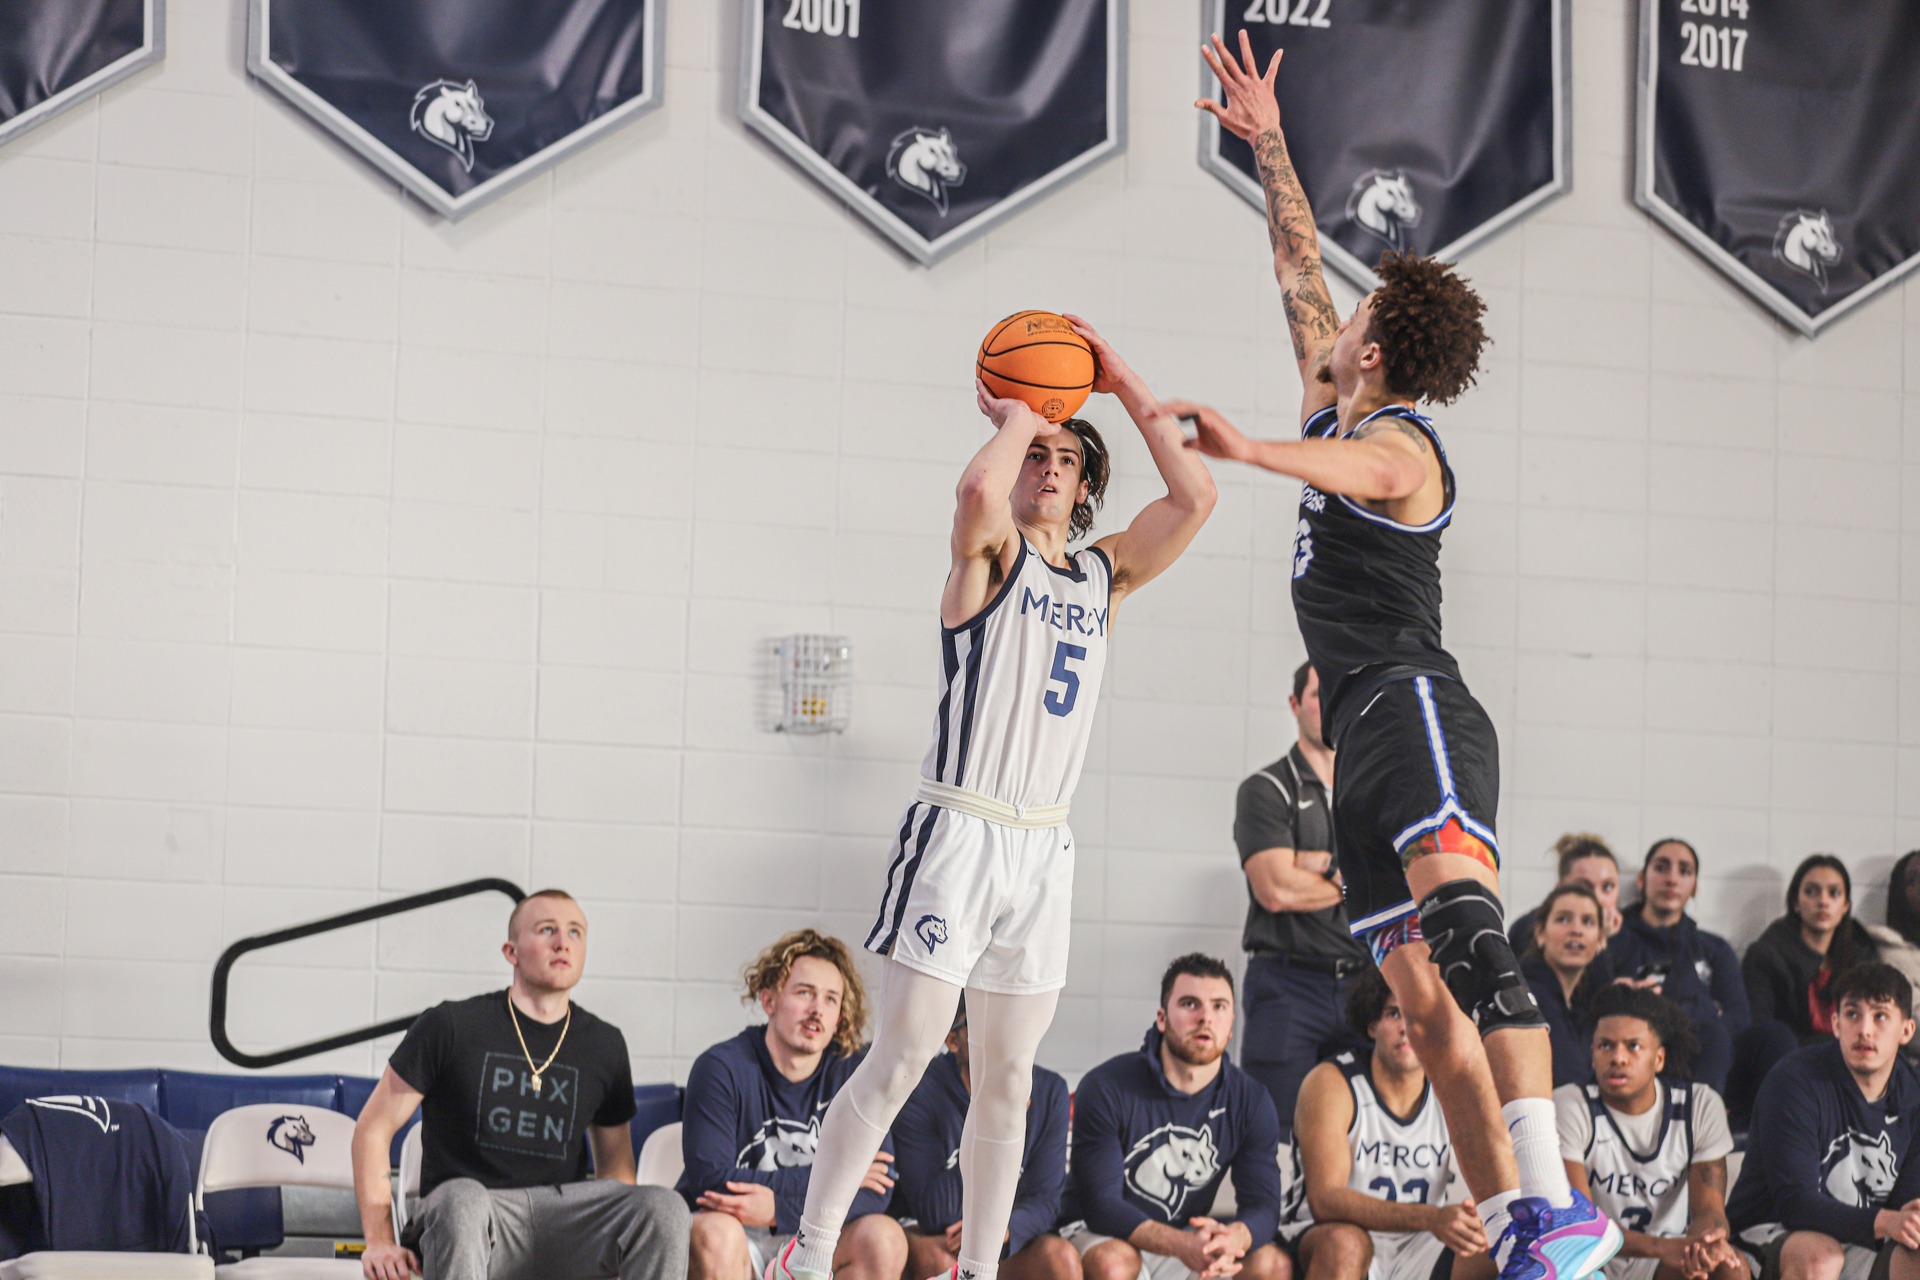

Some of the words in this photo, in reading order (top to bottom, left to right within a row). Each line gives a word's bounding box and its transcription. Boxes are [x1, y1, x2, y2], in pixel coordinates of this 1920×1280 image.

[782, 0, 860, 38] 2001
[1680, 21, 1748, 71] 2017
[1020, 586, 1107, 637] MERCY
[1043, 640, 1087, 717] 5
[493, 1066, 569, 1105] PHX
[488, 1106, 564, 1142] GEN
[1356, 1139, 1448, 1168] MERCY
